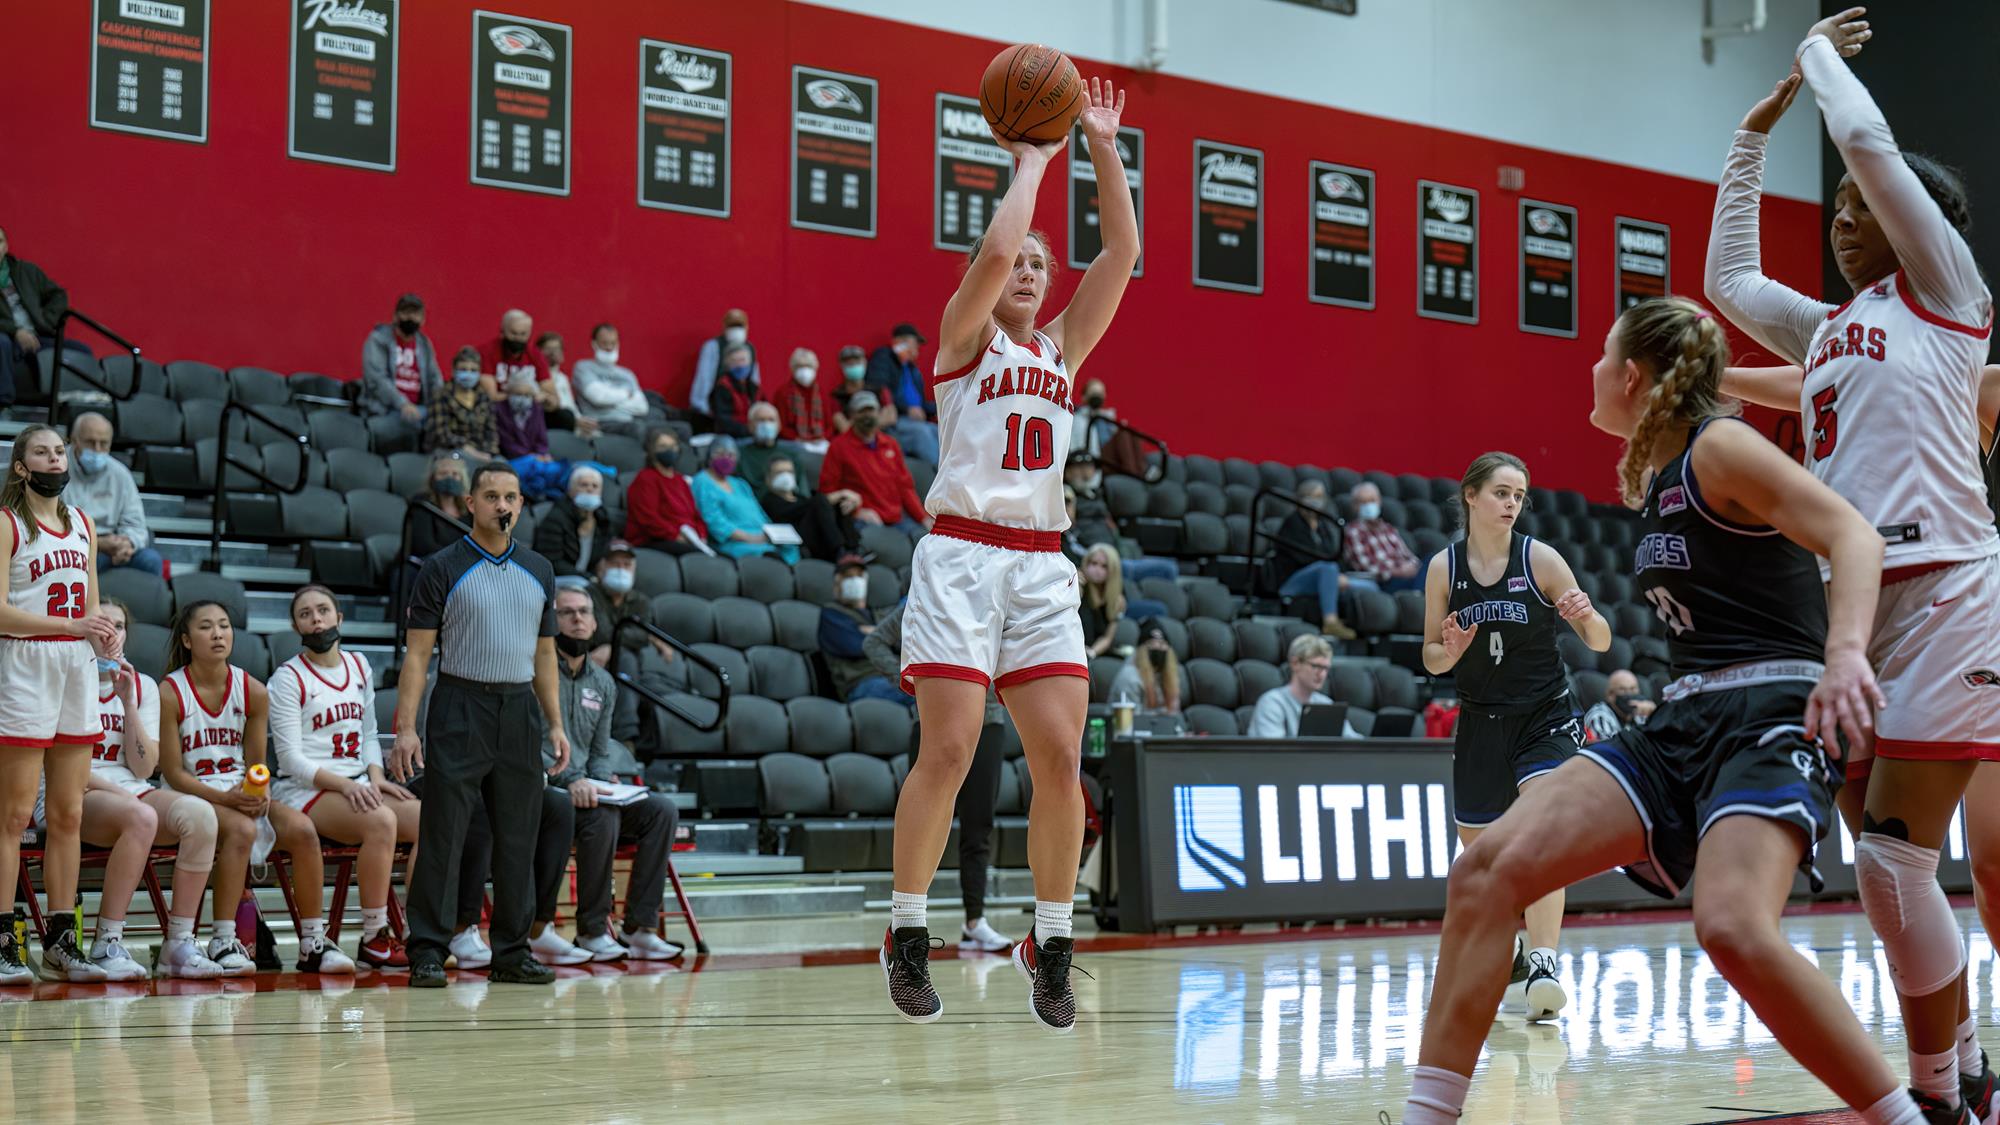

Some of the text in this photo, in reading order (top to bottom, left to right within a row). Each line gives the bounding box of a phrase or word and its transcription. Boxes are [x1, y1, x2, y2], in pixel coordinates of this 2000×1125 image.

[1812, 384, 1838, 462] 5
[1001, 412, 1053, 471] 10
[29, 549, 88, 583] RAIDER
[47, 582, 86, 619] 23
[1458, 601, 1529, 630] YOTES
[1489, 631, 1504, 665] 4
[181, 728, 242, 754] RAIDER
[332, 731, 360, 760] 12
[1258, 784, 1464, 884] LITHI
